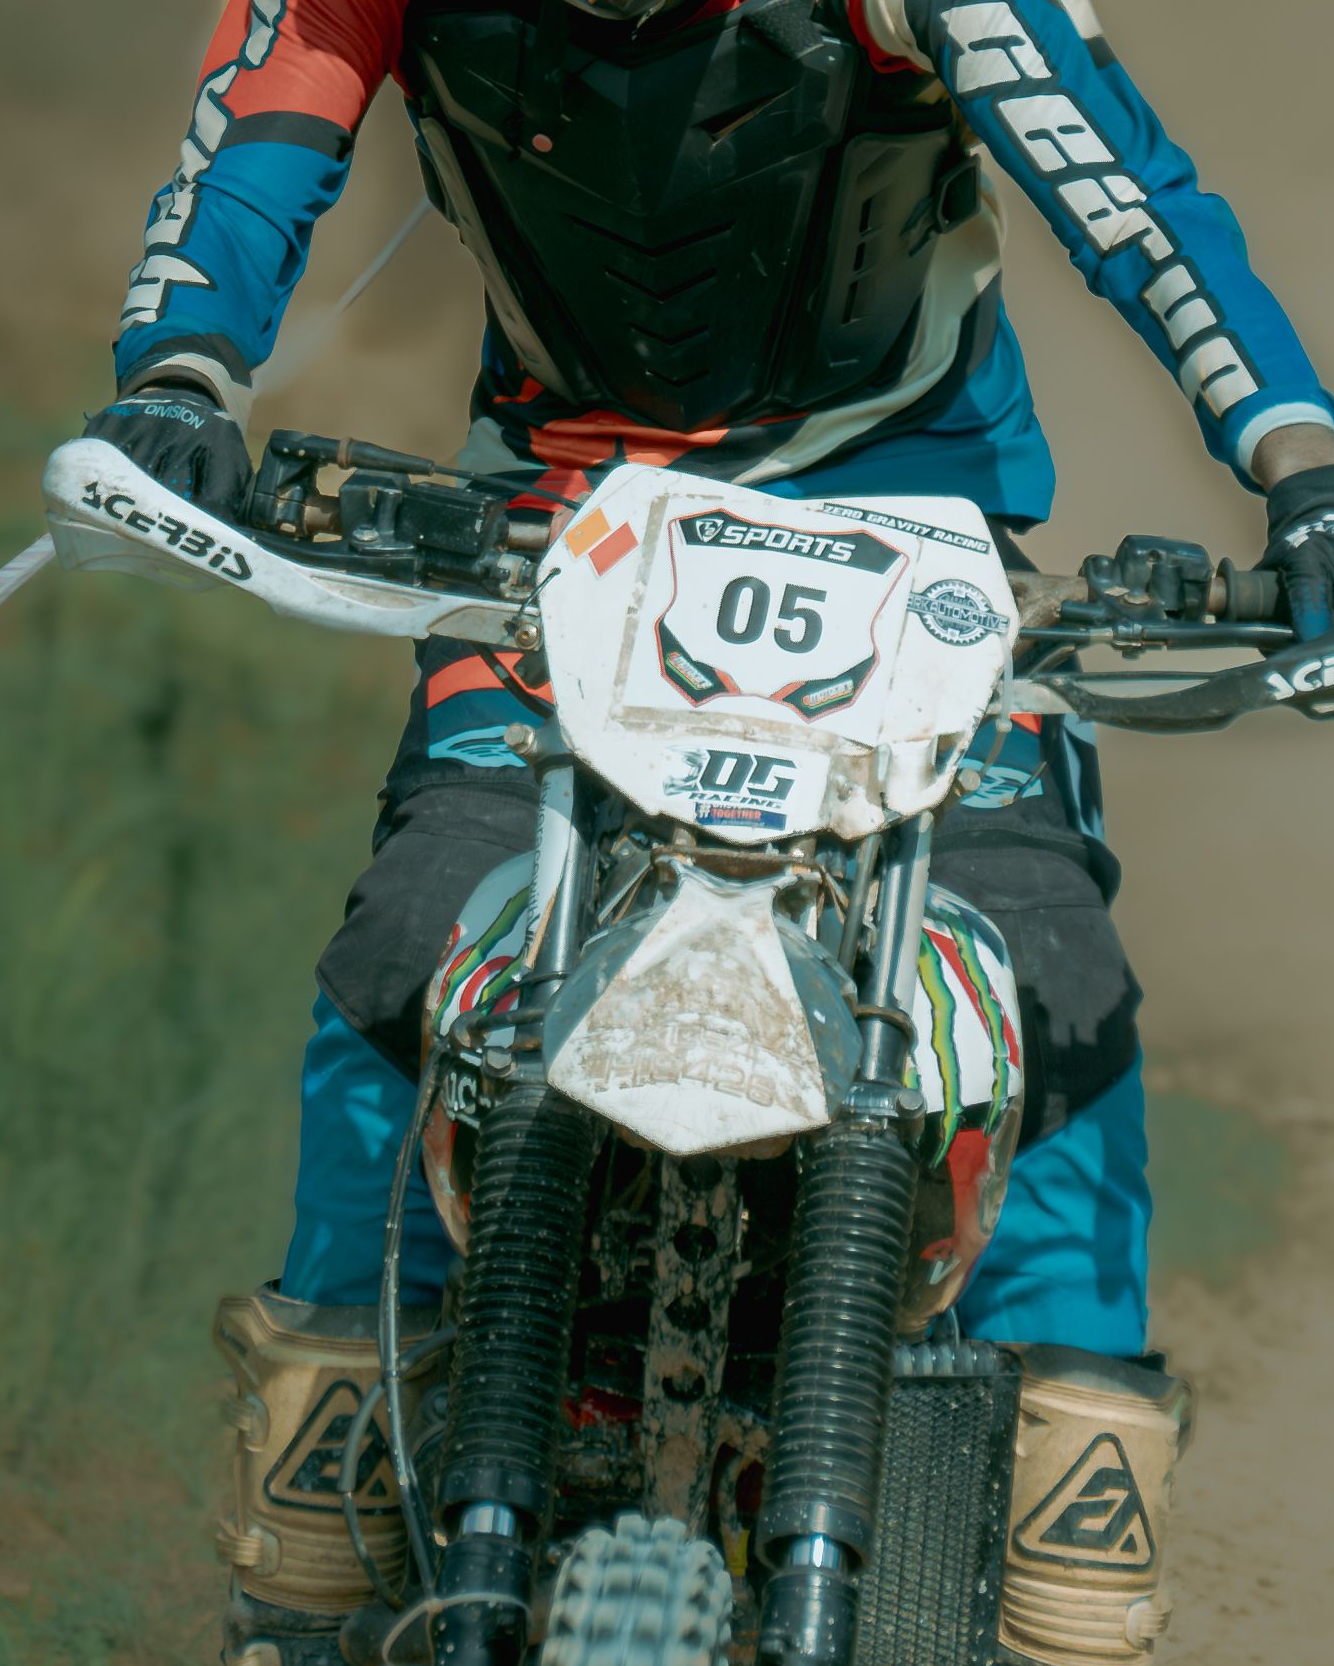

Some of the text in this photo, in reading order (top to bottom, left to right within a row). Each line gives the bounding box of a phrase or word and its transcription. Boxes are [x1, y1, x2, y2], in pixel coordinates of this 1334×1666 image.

[144, 404, 206, 430] DIVISION
[719, 525, 857, 562] SPORTS
[823, 504, 988, 553] ZERO GRAVITY RACING
[717, 575, 827, 654] 05
[688, 792, 783, 809] RACING
